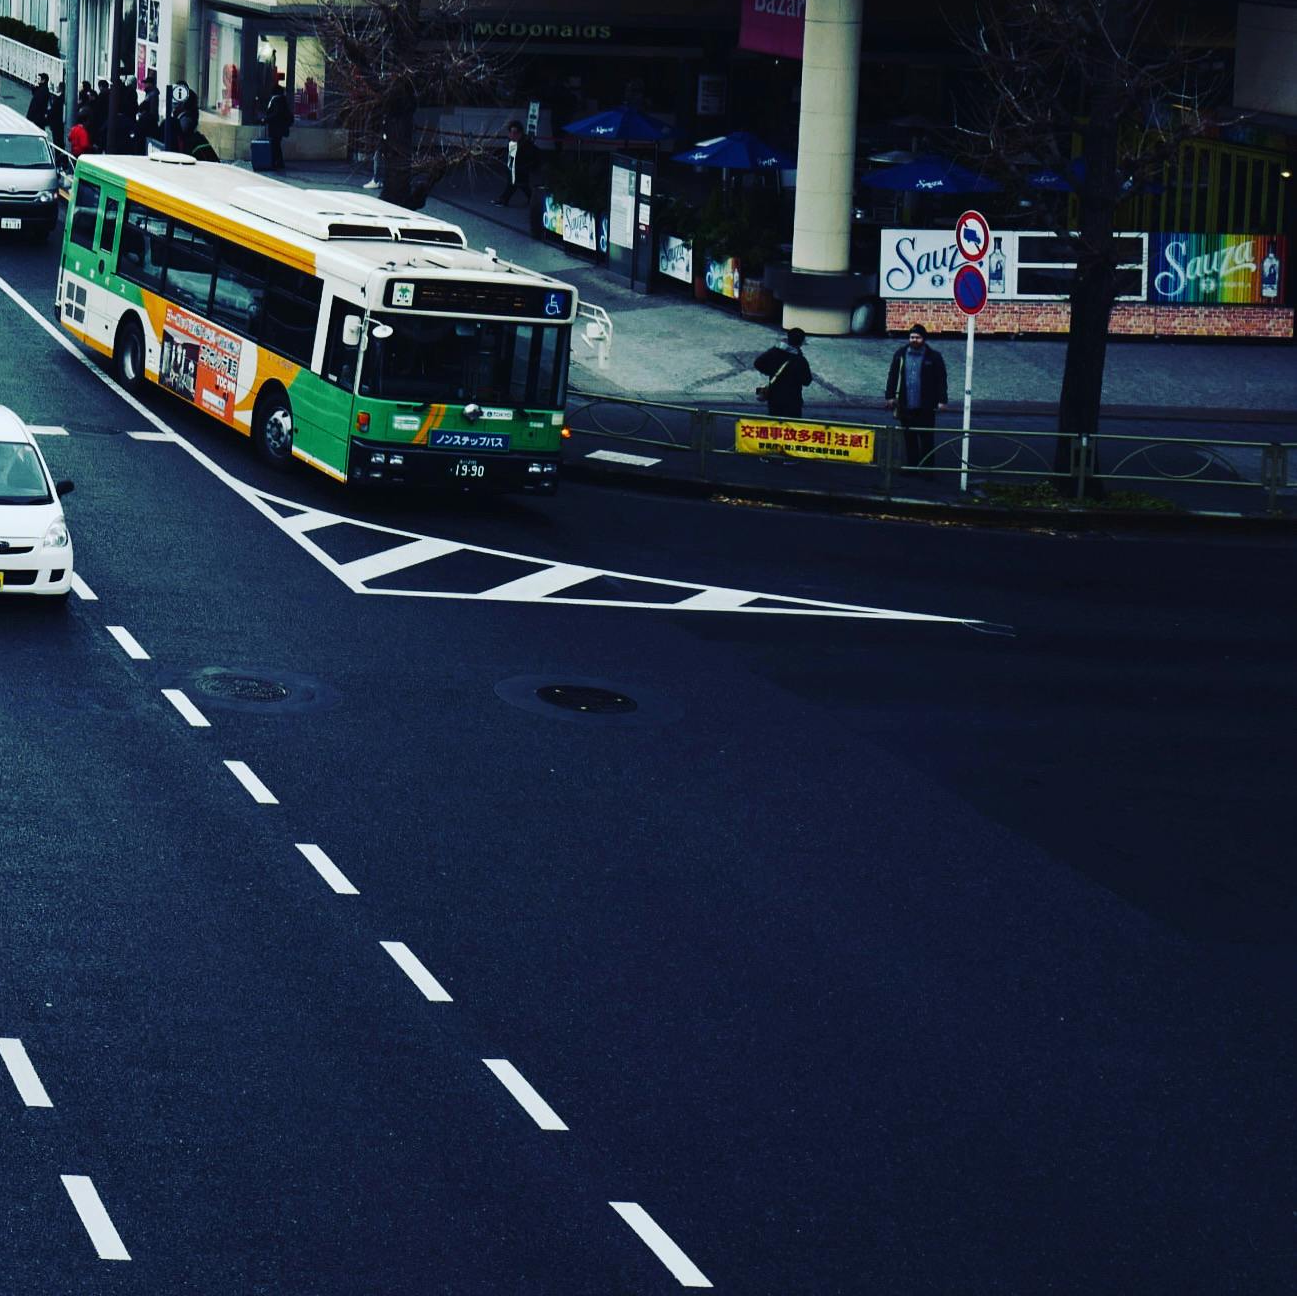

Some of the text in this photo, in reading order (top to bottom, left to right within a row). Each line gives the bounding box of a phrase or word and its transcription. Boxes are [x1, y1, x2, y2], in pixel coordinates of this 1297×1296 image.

[886, 236, 984, 291] Sauz
[1154, 240, 1258, 297] Sauza
[435, 434, 503, 448] ノンステップバス
